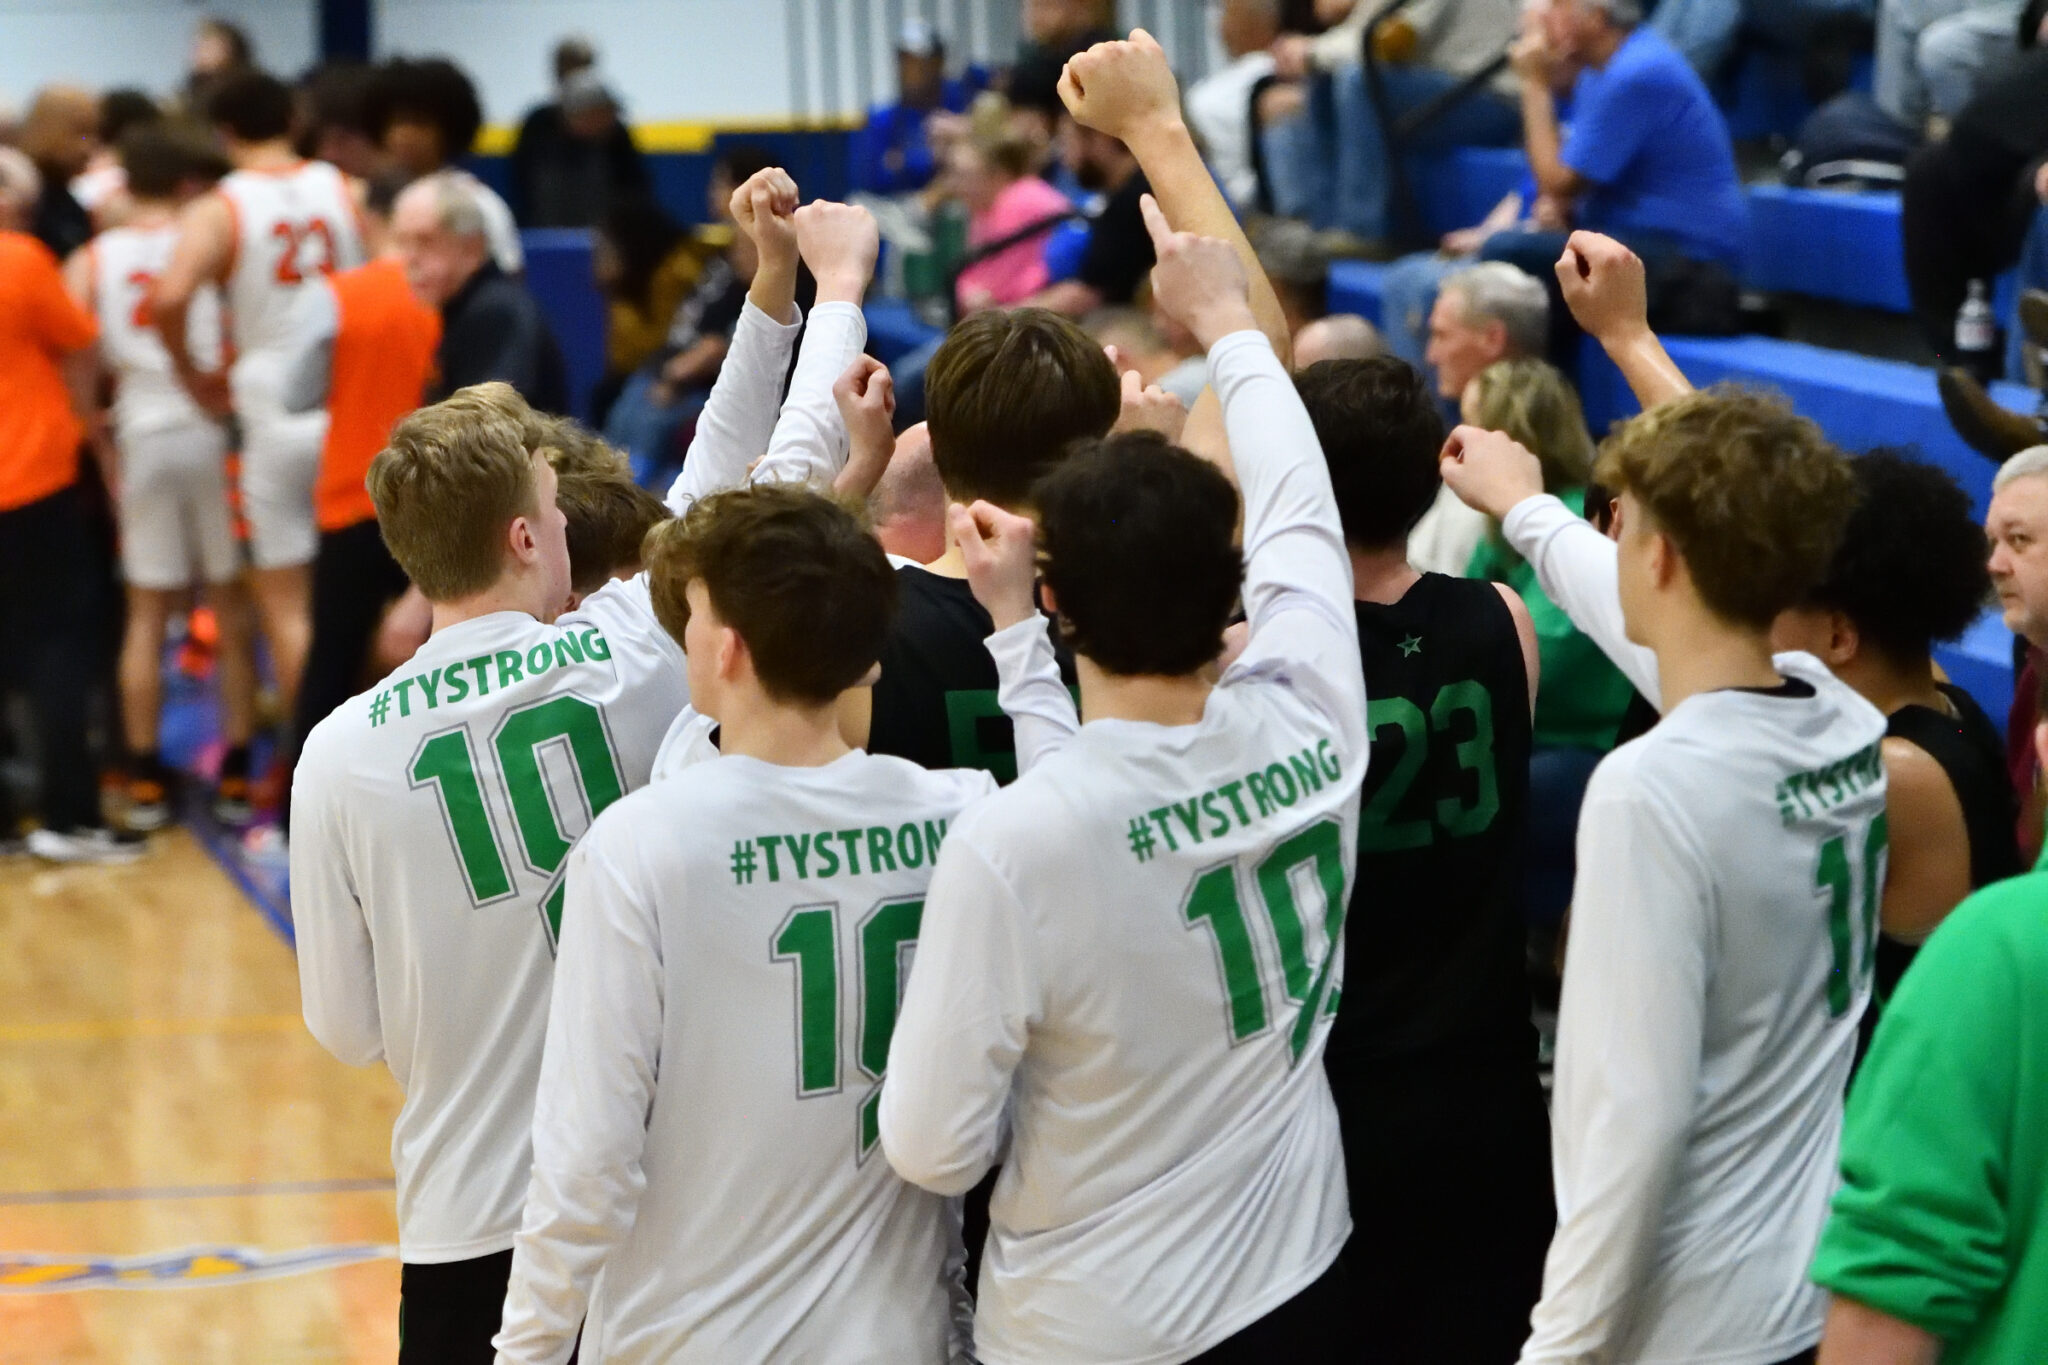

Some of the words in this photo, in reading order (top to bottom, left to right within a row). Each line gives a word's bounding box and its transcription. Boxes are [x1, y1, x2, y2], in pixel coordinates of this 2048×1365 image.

[368, 627, 612, 728] #TYSTRONG
[1127, 738, 1342, 863] #TYSTRONG
[1357, 679, 1500, 853] 23
[730, 818, 948, 885] #TYSTRON
